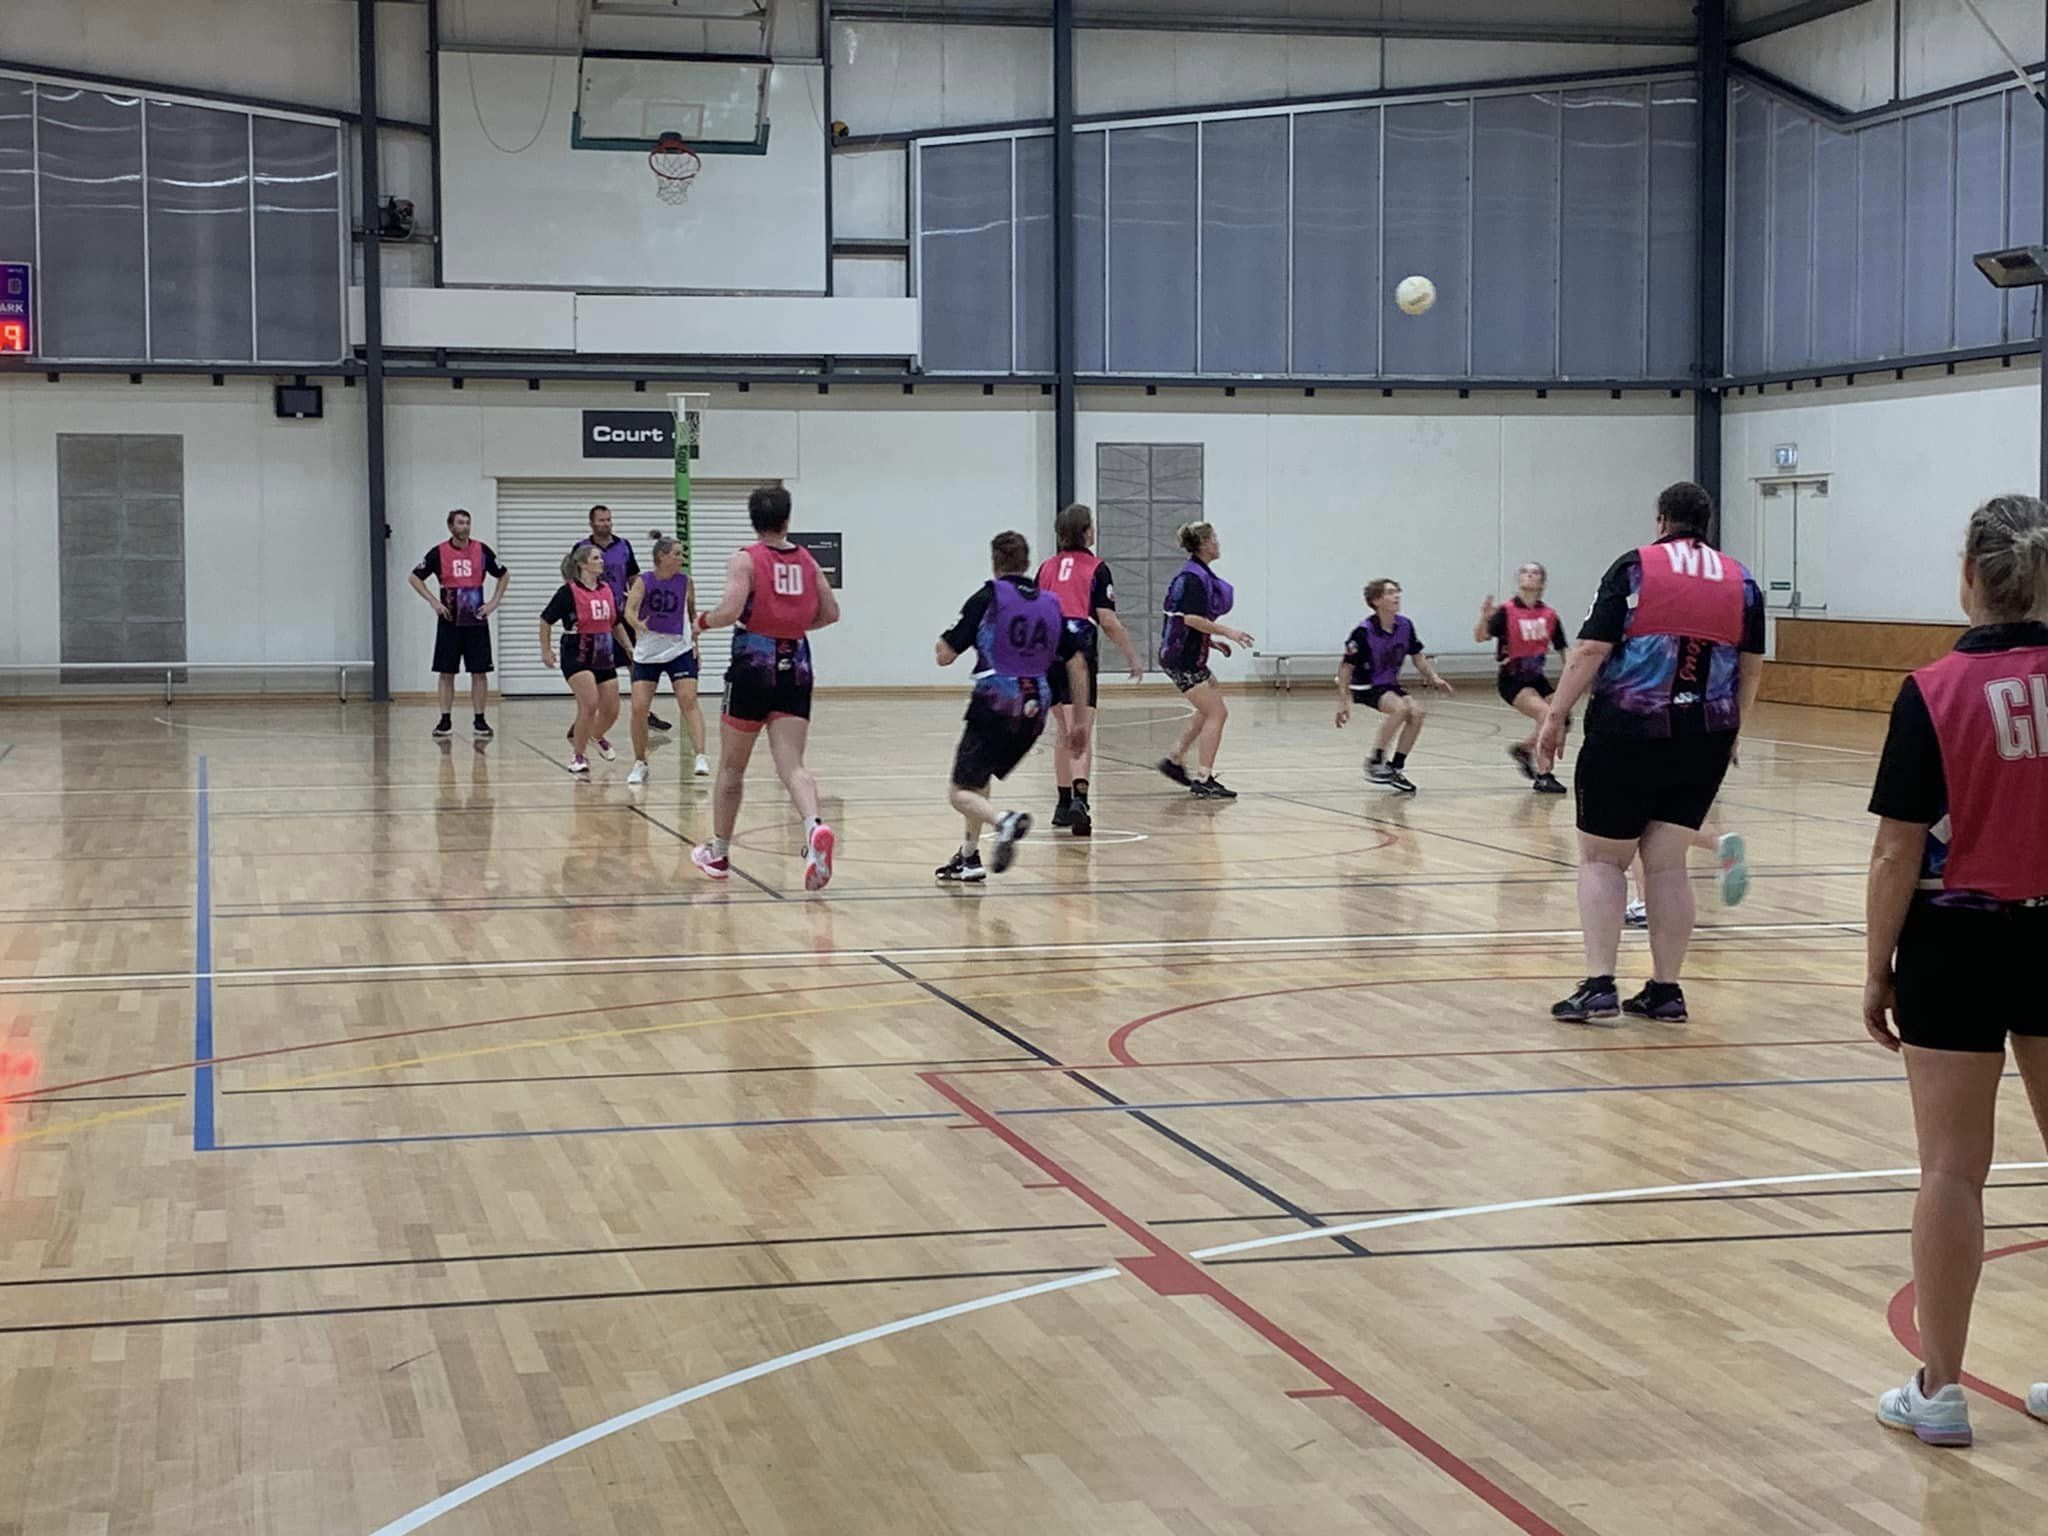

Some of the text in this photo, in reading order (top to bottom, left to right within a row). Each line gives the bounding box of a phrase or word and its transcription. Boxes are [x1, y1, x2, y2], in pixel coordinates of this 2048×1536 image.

[593, 426, 663, 442] Court
[452, 559, 472, 577] GS
[1665, 542, 1724, 581] WD
[773, 562, 804, 596] GD
[590, 599, 610, 620] GA
[648, 588, 680, 613] GD
[1008, 615, 1049, 651] GA
